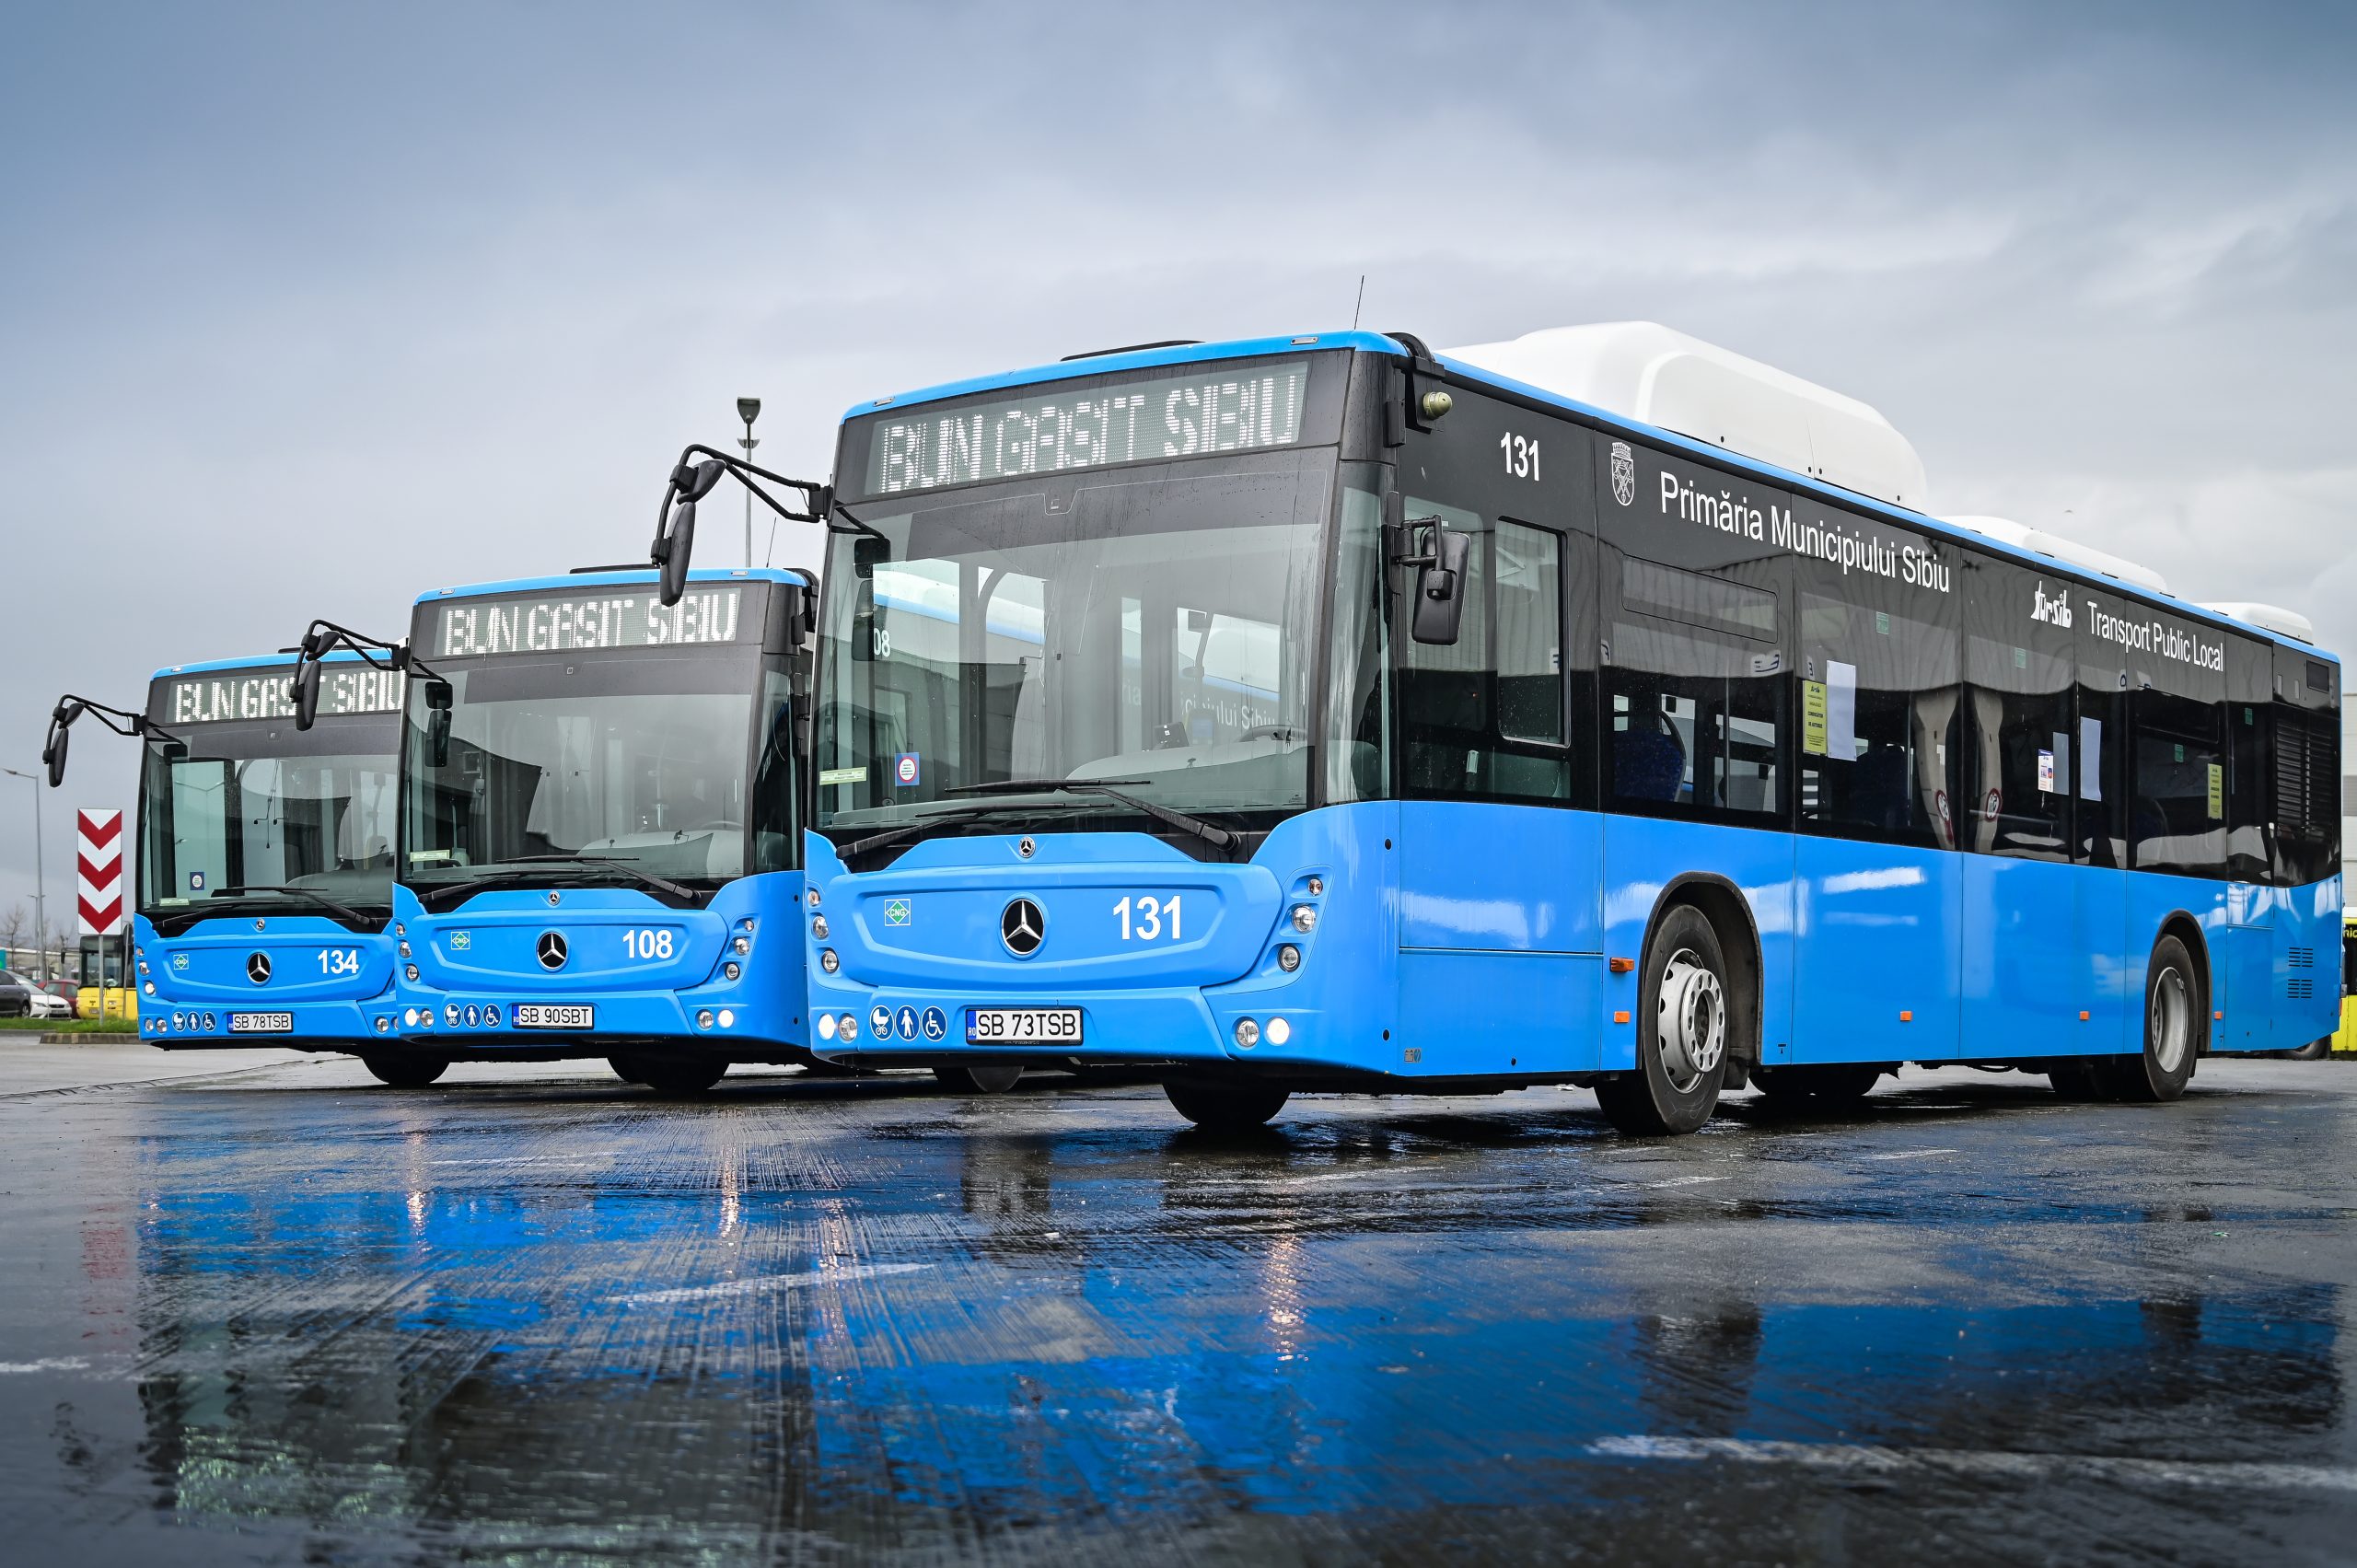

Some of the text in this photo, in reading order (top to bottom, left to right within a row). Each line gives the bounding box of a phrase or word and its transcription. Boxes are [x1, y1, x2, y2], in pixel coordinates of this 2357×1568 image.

[878, 413, 981, 494] BUN
[1164, 375, 1295, 458] SIBIU
[1501, 432, 1539, 481] 131
[1660, 470, 1949, 592] Primăria Municipiului Sibiu
[445, 606, 519, 656] BUN
[645, 593, 737, 645] SIBIU
[2087, 601, 2223, 671] Transport Public Local
[874, 628, 890, 657] 08
[176, 681, 235, 723] BUN
[889, 908, 906, 917] CNG
[1112, 895, 1181, 940] 131
[622, 929, 673, 958] 108
[318, 949, 359, 974] 134
[234, 1016, 250, 1028] SB
[252, 1015, 289, 1028] 78TSB
[520, 1007, 589, 1024] SB 90SBT
[978, 1013, 1076, 1037] SB 73TSB
